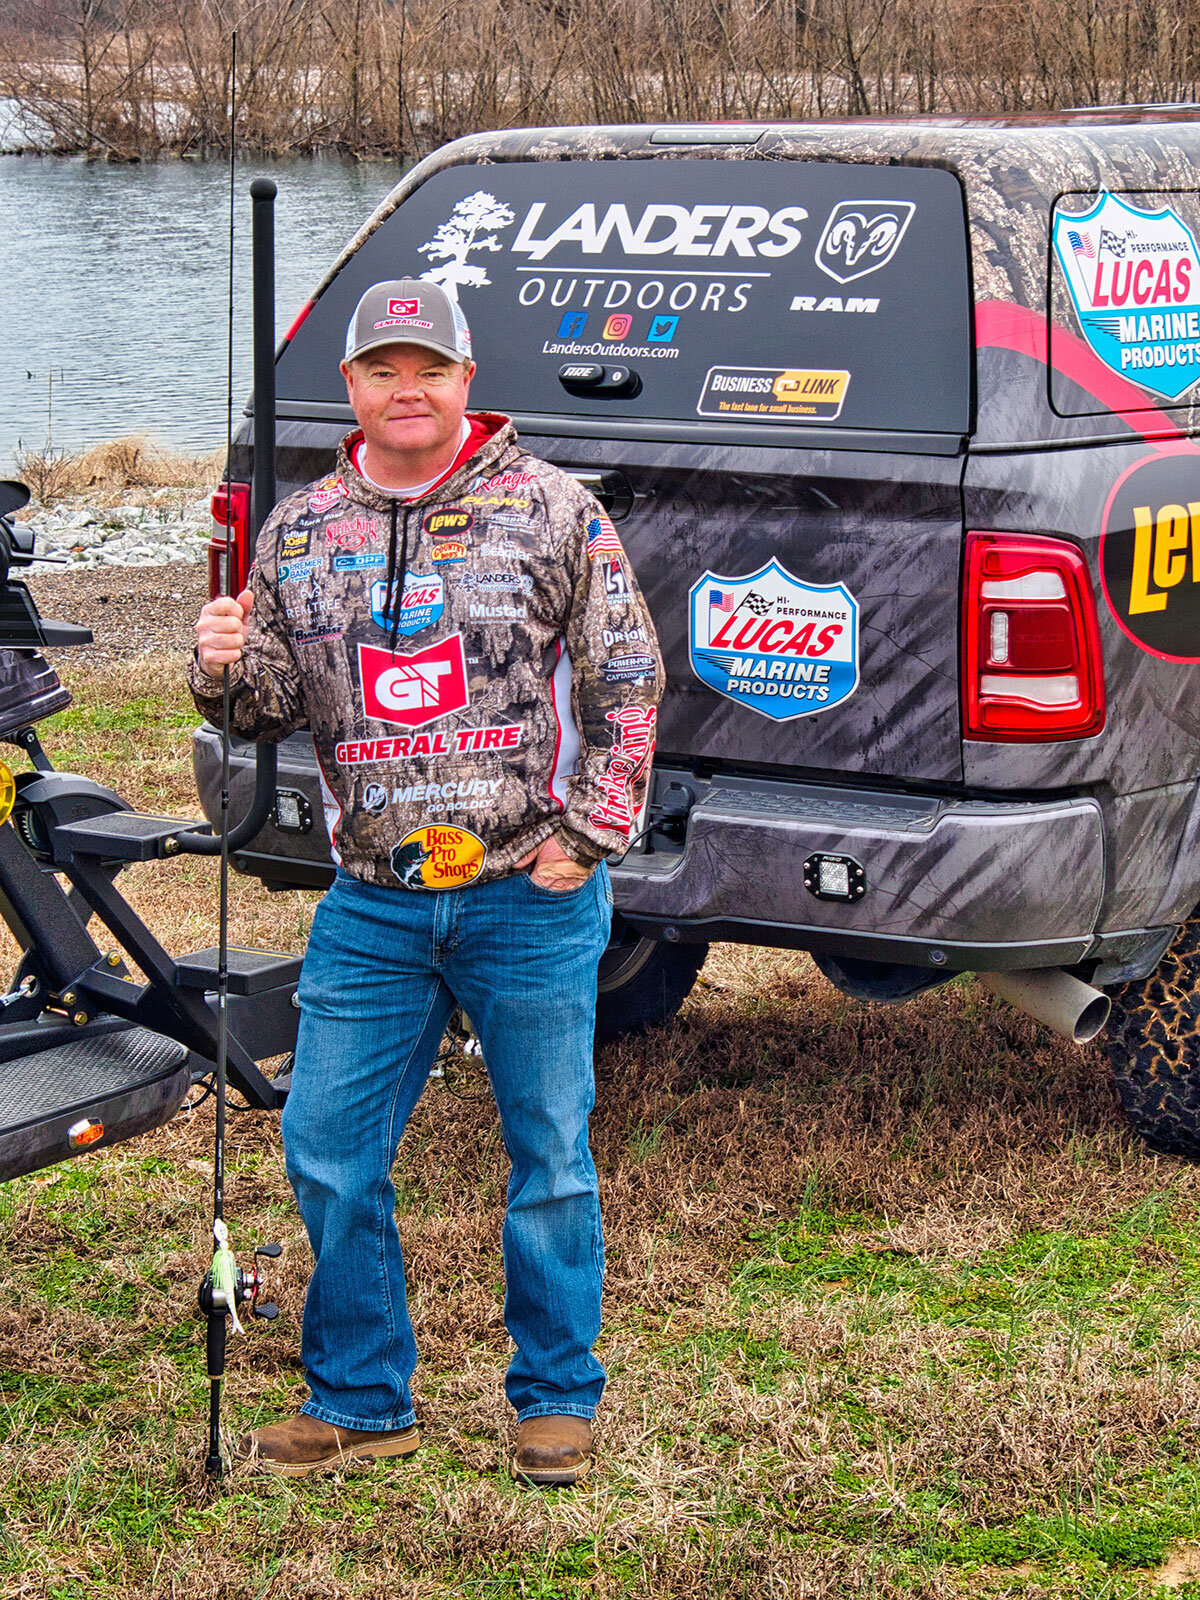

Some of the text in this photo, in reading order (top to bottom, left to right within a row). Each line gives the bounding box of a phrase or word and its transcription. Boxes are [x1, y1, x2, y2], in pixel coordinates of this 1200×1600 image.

[511, 203, 808, 260] LANDERS
[1126, 230, 1138, 240] HI-
[1131, 242, 1189, 253] PERFORMANCE
[1092, 257, 1192, 307] LUCAS
[518, 278, 752, 312] OUTDOORS
[790, 296, 880, 313] RAM
[374, 318, 434, 330] GENERAL TIRE
[1119, 312, 1200, 343] MARINE
[542, 341, 679, 359] LandersOutdoors.com
[711, 375, 840, 394] BUSINESS LINK
[719, 401, 817, 414] The fast lane for small business.
[468, 473, 537, 494] Ranger
[461, 496, 530, 508] PLANO
[290, 559, 322, 570] PREMIER
[290, 569, 311, 579] BANK
[476, 573, 521, 584] LANDERS
[285, 599, 341, 619] REALTREE
[777, 596, 790, 604] HI-
[469, 602, 527, 618] Mustad
[776, 607, 847, 620] PERFORMANCE
[709, 615, 843, 658] LUCAS
[730, 657, 831, 683] MARINE
[726, 679, 830, 702] PRODUCTS
[336, 724, 523, 765] GENERAL TIRE
[391, 778, 504, 804] MERCURY
[426, 800, 491, 813] GO BOLDLY
[426, 828, 463, 847] Bass
[431, 846, 456, 863] Pro
[433, 859, 479, 879] Shops
